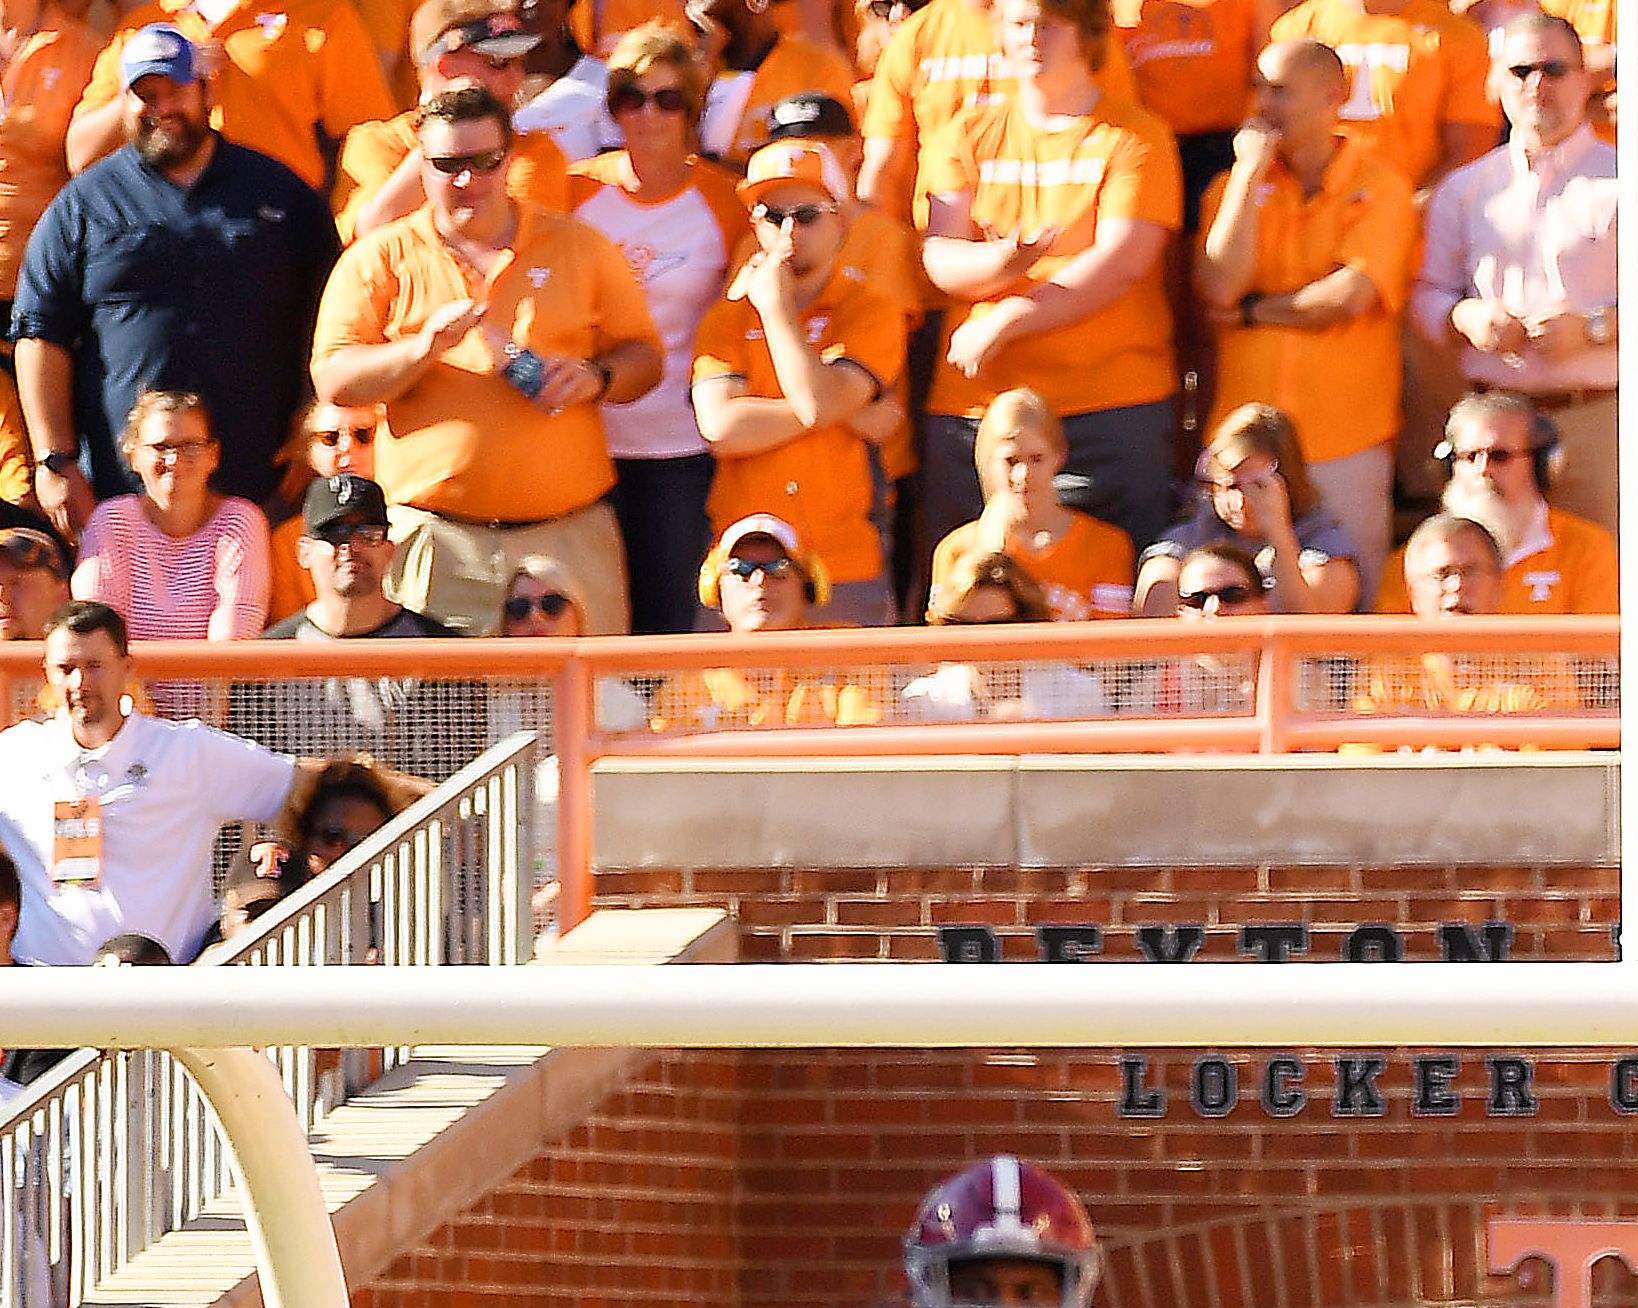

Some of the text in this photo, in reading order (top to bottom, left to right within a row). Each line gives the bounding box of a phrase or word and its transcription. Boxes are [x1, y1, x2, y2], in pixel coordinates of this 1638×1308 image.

[1523, 571, 1561, 601] T
[249, 841, 291, 879] T
[1118, 1053, 1540, 1119] LOCKER
